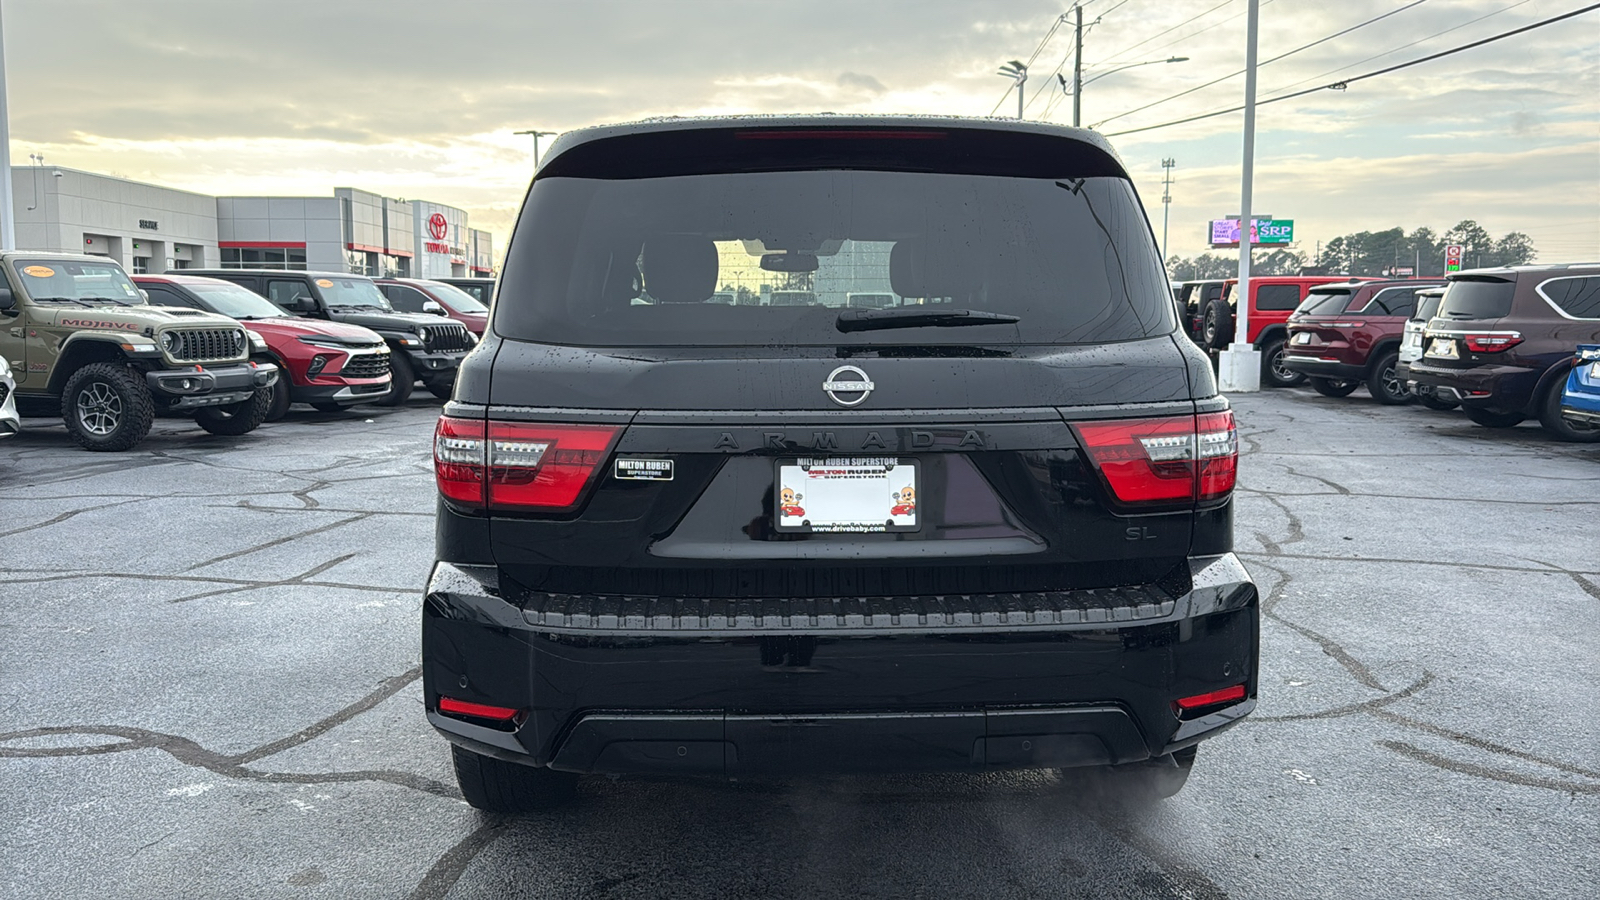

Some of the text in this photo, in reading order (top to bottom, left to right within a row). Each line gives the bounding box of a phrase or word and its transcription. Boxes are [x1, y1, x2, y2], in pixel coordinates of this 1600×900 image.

[1260, 226, 1291, 235] SRP
[425, 242, 449, 254] TOYOTA
[62, 319, 139, 330] MOJAVE
[714, 430, 985, 450] ARMADA
[618, 461, 670, 470] MILTON RUBEN
[797, 458, 898, 466] MILTON RUBEN SUPERSTORE
[1125, 526, 1157, 540] SL
